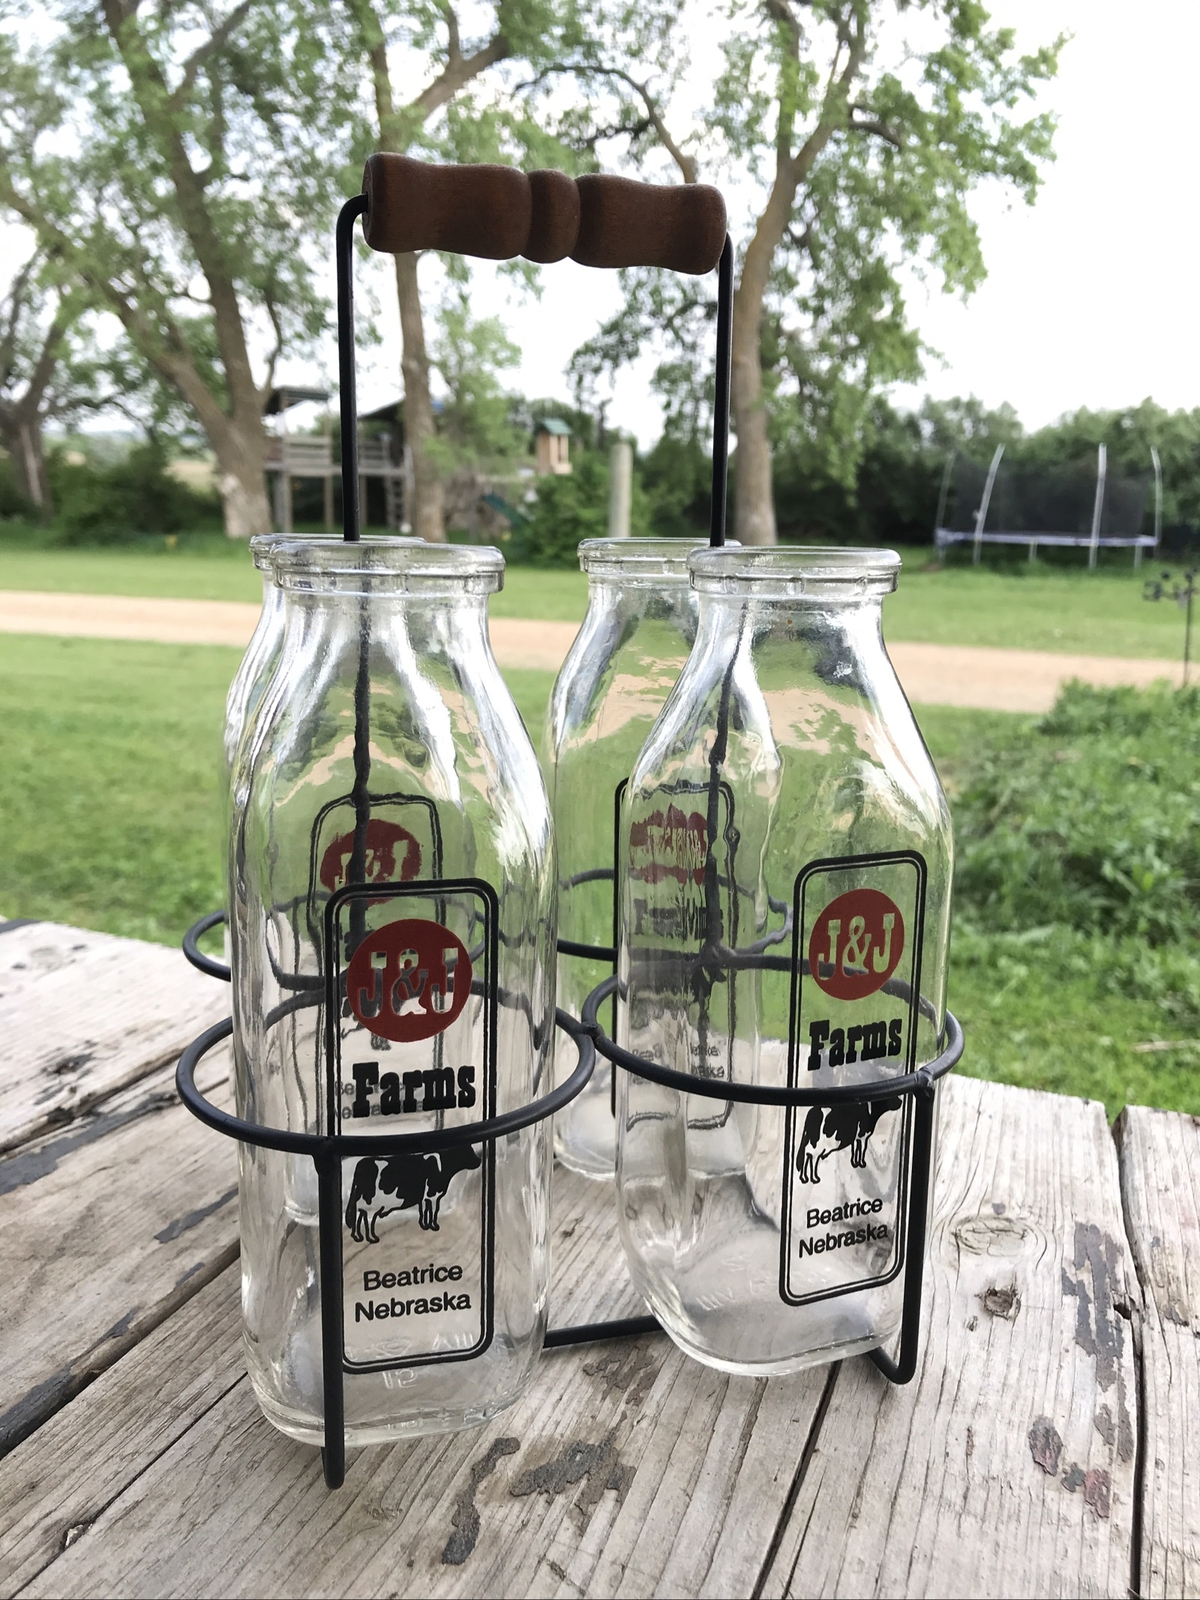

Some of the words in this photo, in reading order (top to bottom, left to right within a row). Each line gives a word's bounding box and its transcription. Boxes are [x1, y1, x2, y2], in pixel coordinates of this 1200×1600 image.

[817, 912, 896, 981] J&J
[358, 947, 459, 1019] J&J
[807, 1018, 903, 1072] Farms
[352, 1061, 476, 1119] Farms
[806, 1197, 884, 1229] Beatrice
[798, 1223, 889, 1259] Nebraska
[362, 1263, 464, 1292] Beatrice
[354, 1291, 472, 1323] Nebraska
